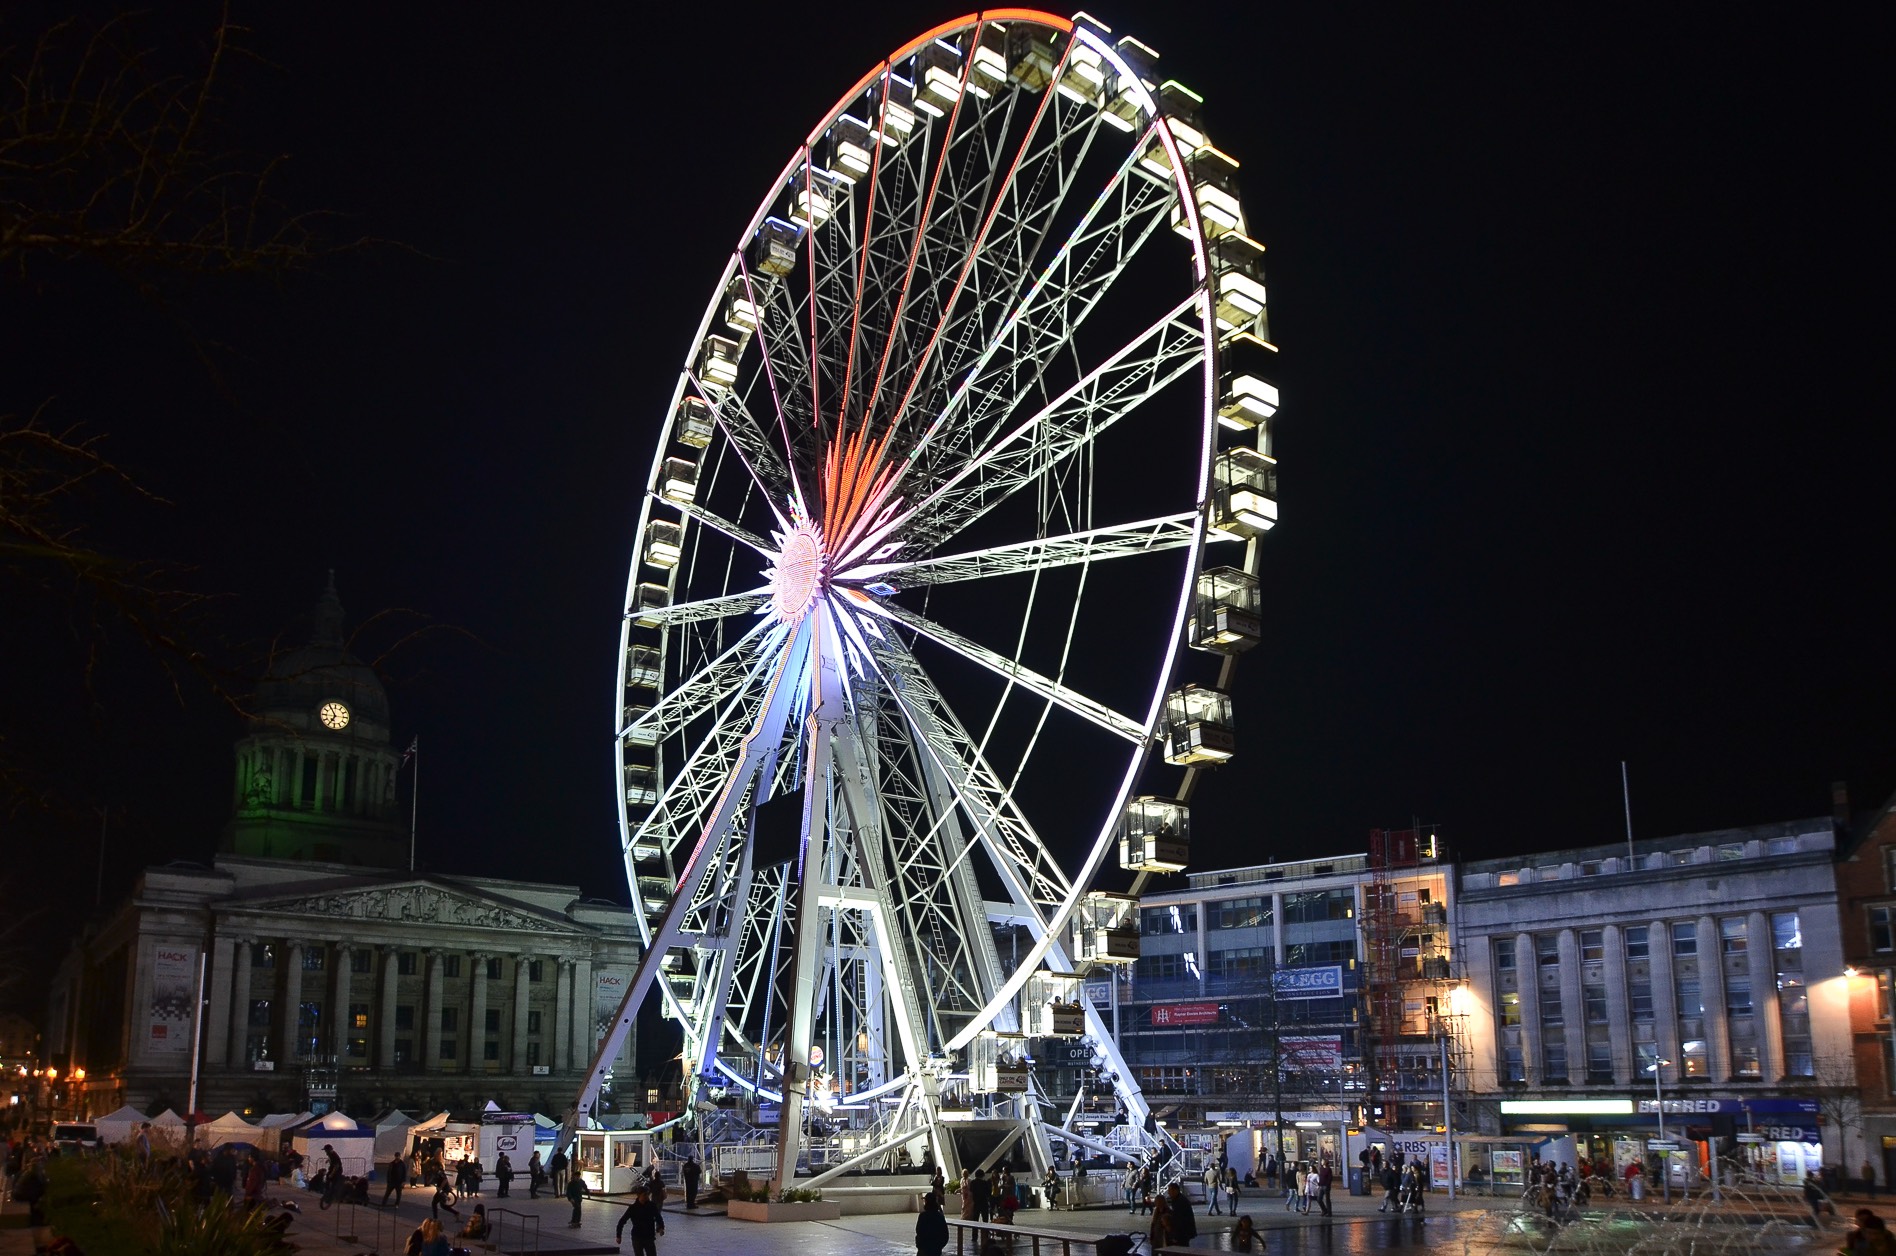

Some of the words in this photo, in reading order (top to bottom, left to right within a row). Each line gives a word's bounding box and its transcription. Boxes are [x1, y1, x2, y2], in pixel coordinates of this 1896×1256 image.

[158, 951, 188, 962] HACK
[599, 976, 621, 986] HACK
[1404, 1141, 1426, 1153] RBS
